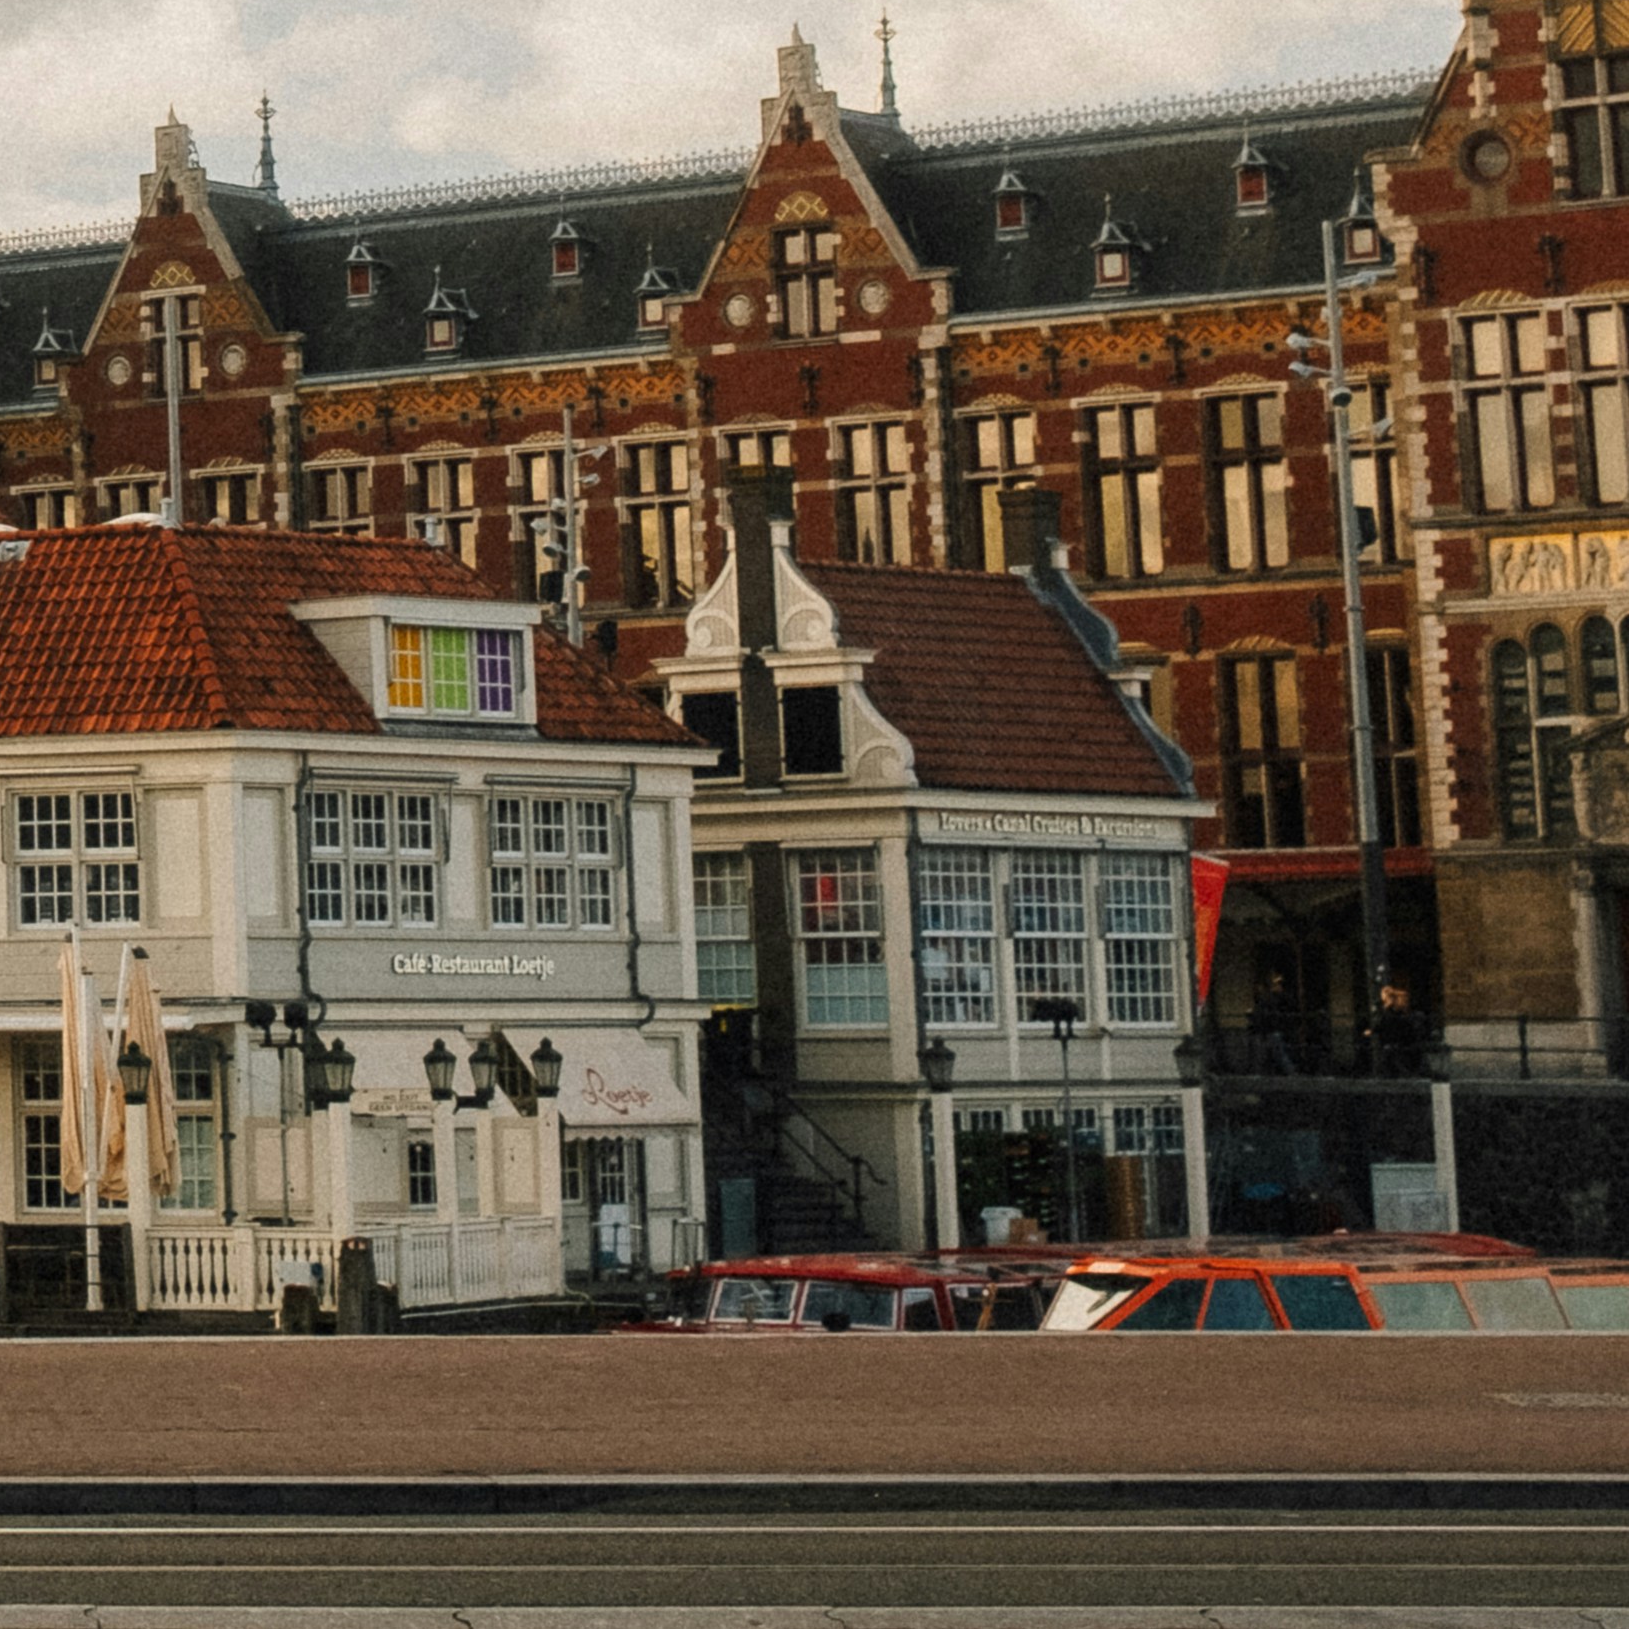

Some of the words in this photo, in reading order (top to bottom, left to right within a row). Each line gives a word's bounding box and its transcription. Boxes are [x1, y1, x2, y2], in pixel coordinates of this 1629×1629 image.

[994, 813, 1031, 832] Canal
[393, 953, 510, 974] Café-Restaurant
[512, 954, 555, 981] Loetje
